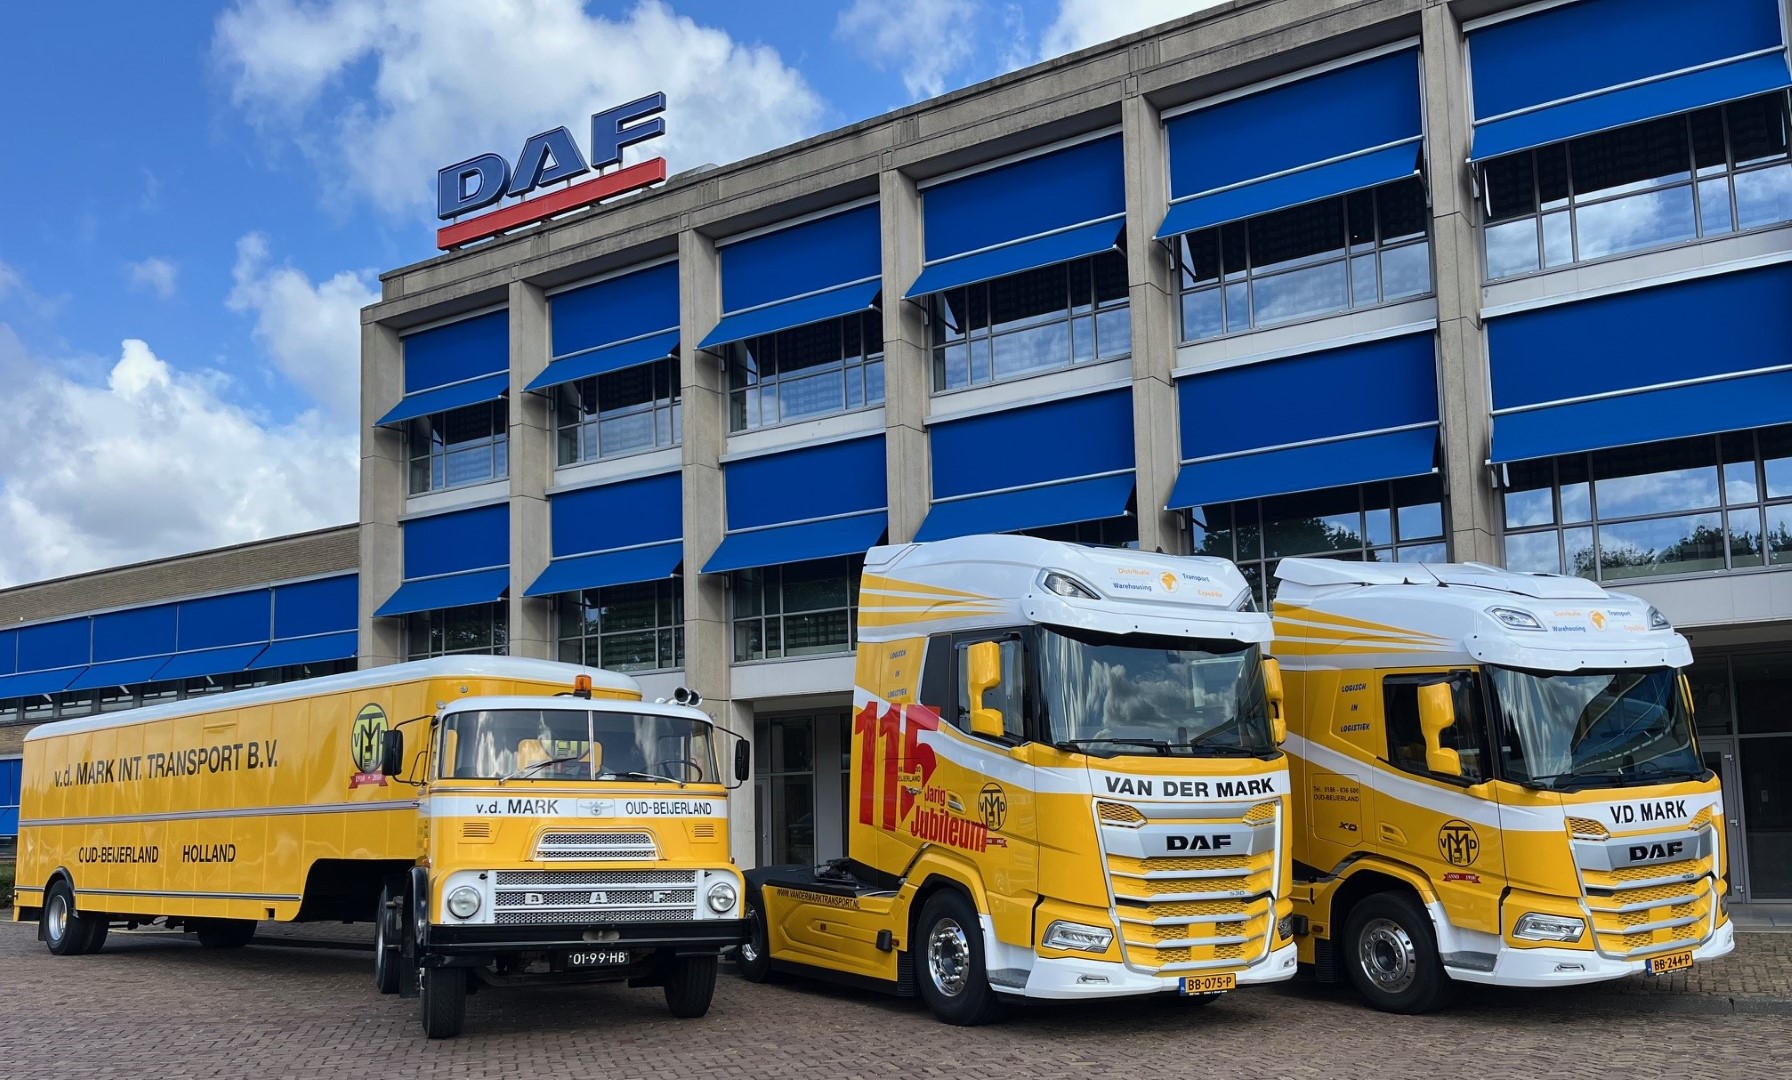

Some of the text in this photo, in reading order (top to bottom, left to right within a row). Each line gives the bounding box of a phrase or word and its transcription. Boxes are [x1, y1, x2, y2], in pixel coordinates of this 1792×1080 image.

[438, 91, 666, 220] DAF
[1182, 573, 1210, 583] Transport
[1113, 582, 1152, 592] Warehousing
[1552, 625, 1586, 633] Warehousing
[1341, 682, 1367, 693] LOGISCH
[1340, 722, 1370, 733] LOGISTIEK
[54, 739, 278, 787] v.d. MARK INT. TRANSPORT B.V.
[855, 701, 940, 832] 115
[1105, 776, 1275, 798] VAN DER MARK
[925, 785, 946, 807] Jarig
[1313, 794, 1360, 802] OUD-BEIJERLAND
[476, 799, 712, 816] v.d. MARK OUD-BEIJERLAND
[1610, 800, 1688, 824] V.D. MARK
[911, 805, 988, 853] Jubileum
[1166, 834, 1232, 851] DAF
[78, 843, 236, 864] OUD-BEIJERLAND HOLLAND
[1629, 841, 1683, 862] DAF
[524, 890, 673, 906] DAF
[1654, 953, 1690, 971] BB-244-P
[1188, 976, 1232, 991] BB-075-P
